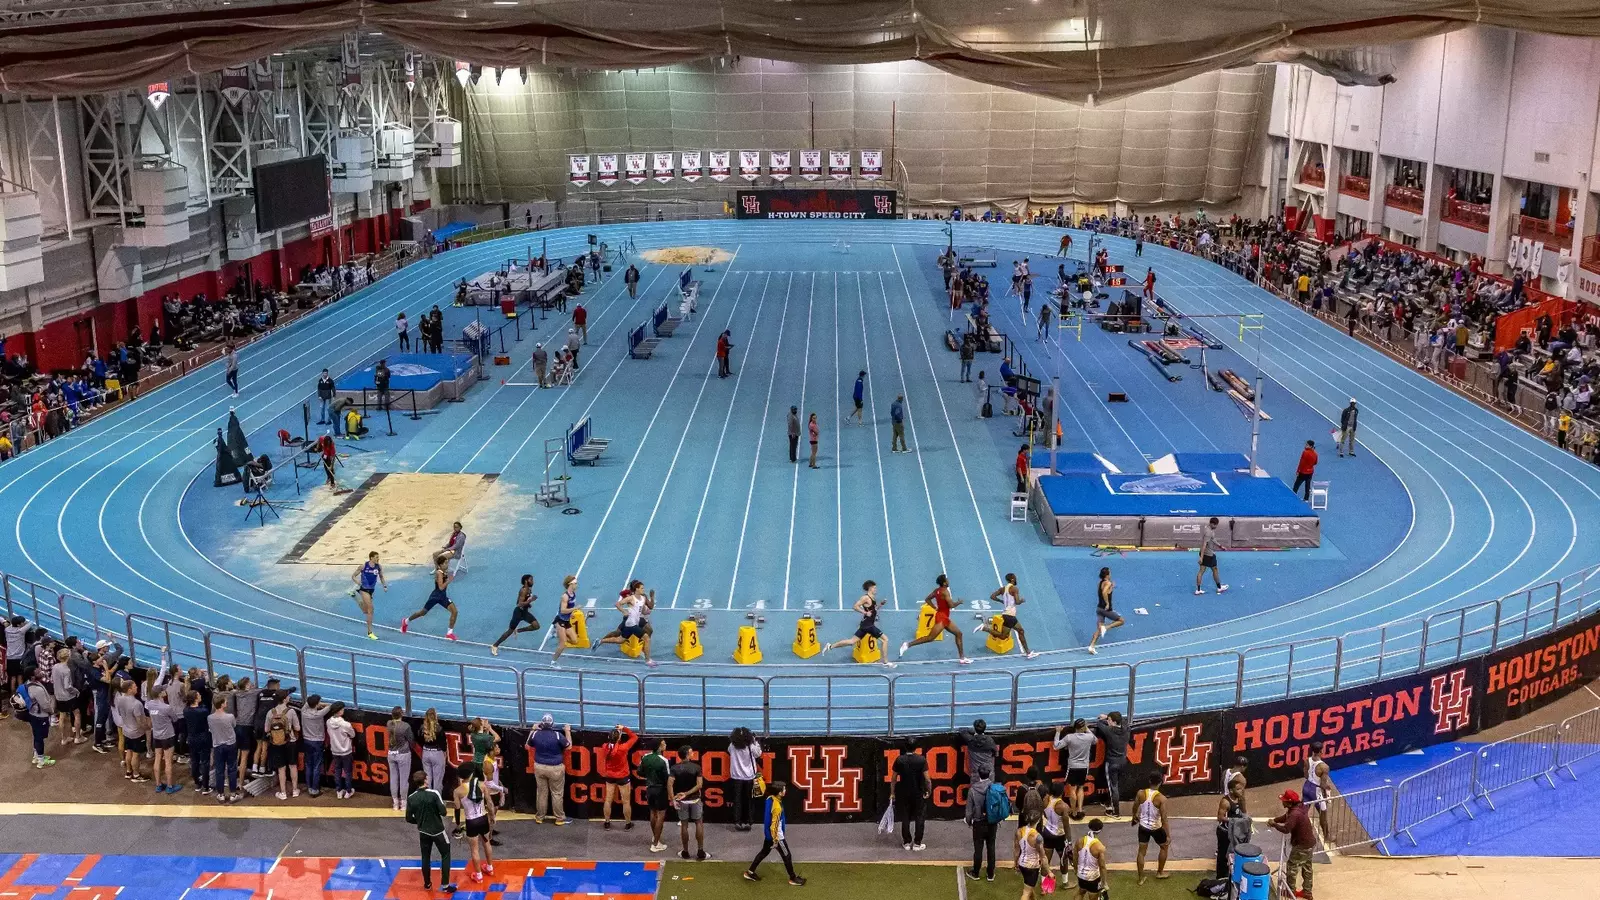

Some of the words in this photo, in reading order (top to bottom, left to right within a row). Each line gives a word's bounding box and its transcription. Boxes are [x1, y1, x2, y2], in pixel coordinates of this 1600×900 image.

[742, 195, 760, 214] UH
[873, 195, 892, 214] UH
[1084, 523, 1112, 531] UCS
[1173, 524, 1201, 533] UCS
[1262, 523, 1290, 532] UCS
[693, 599, 713, 609] 3
[804, 600, 824, 610] 5
[971, 599, 992, 610] 8
[924, 613, 934, 628] 7
[571, 621, 579, 637] 1
[797, 627, 803, 643] 5
[809, 627, 815, 644] 5
[689, 630, 697, 646] 3
[749, 635, 757, 651] 4
[868, 635, 876, 650] 6
[1486, 624, 1600, 694] HOUSTON
[1507, 664, 1579, 707] COUGARS
[1429, 668, 1473, 735] UH
[1233, 686, 1424, 751] HOUSTON
[1154, 723, 1214, 784] UH
[787, 745, 863, 812] UH
